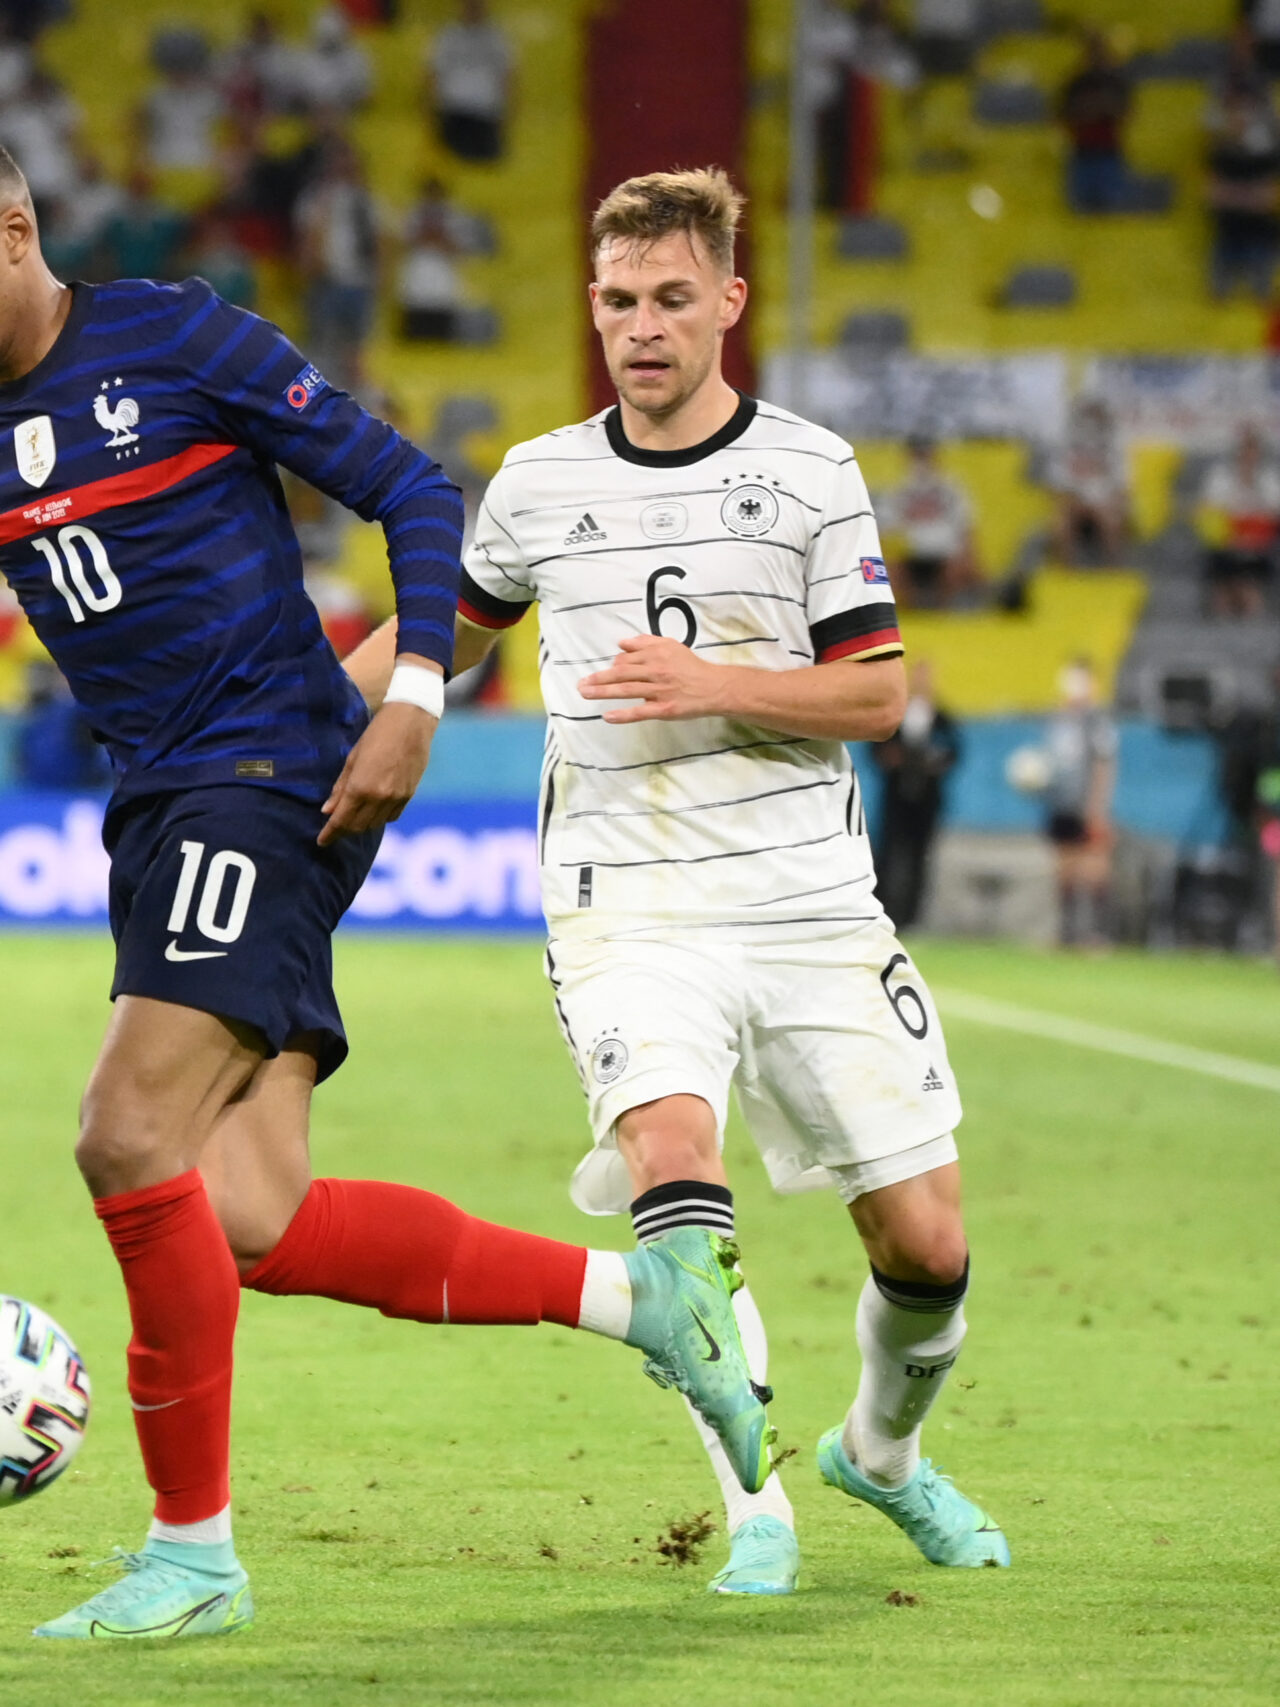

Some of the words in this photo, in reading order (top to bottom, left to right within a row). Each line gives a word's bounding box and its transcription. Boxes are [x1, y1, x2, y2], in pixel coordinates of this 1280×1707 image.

[30, 524, 123, 624] 10
[563, 531, 608, 546] adidas
[646, 565, 697, 649] 6
[166, 839, 257, 944] 10
[880, 953, 928, 1040] 6
